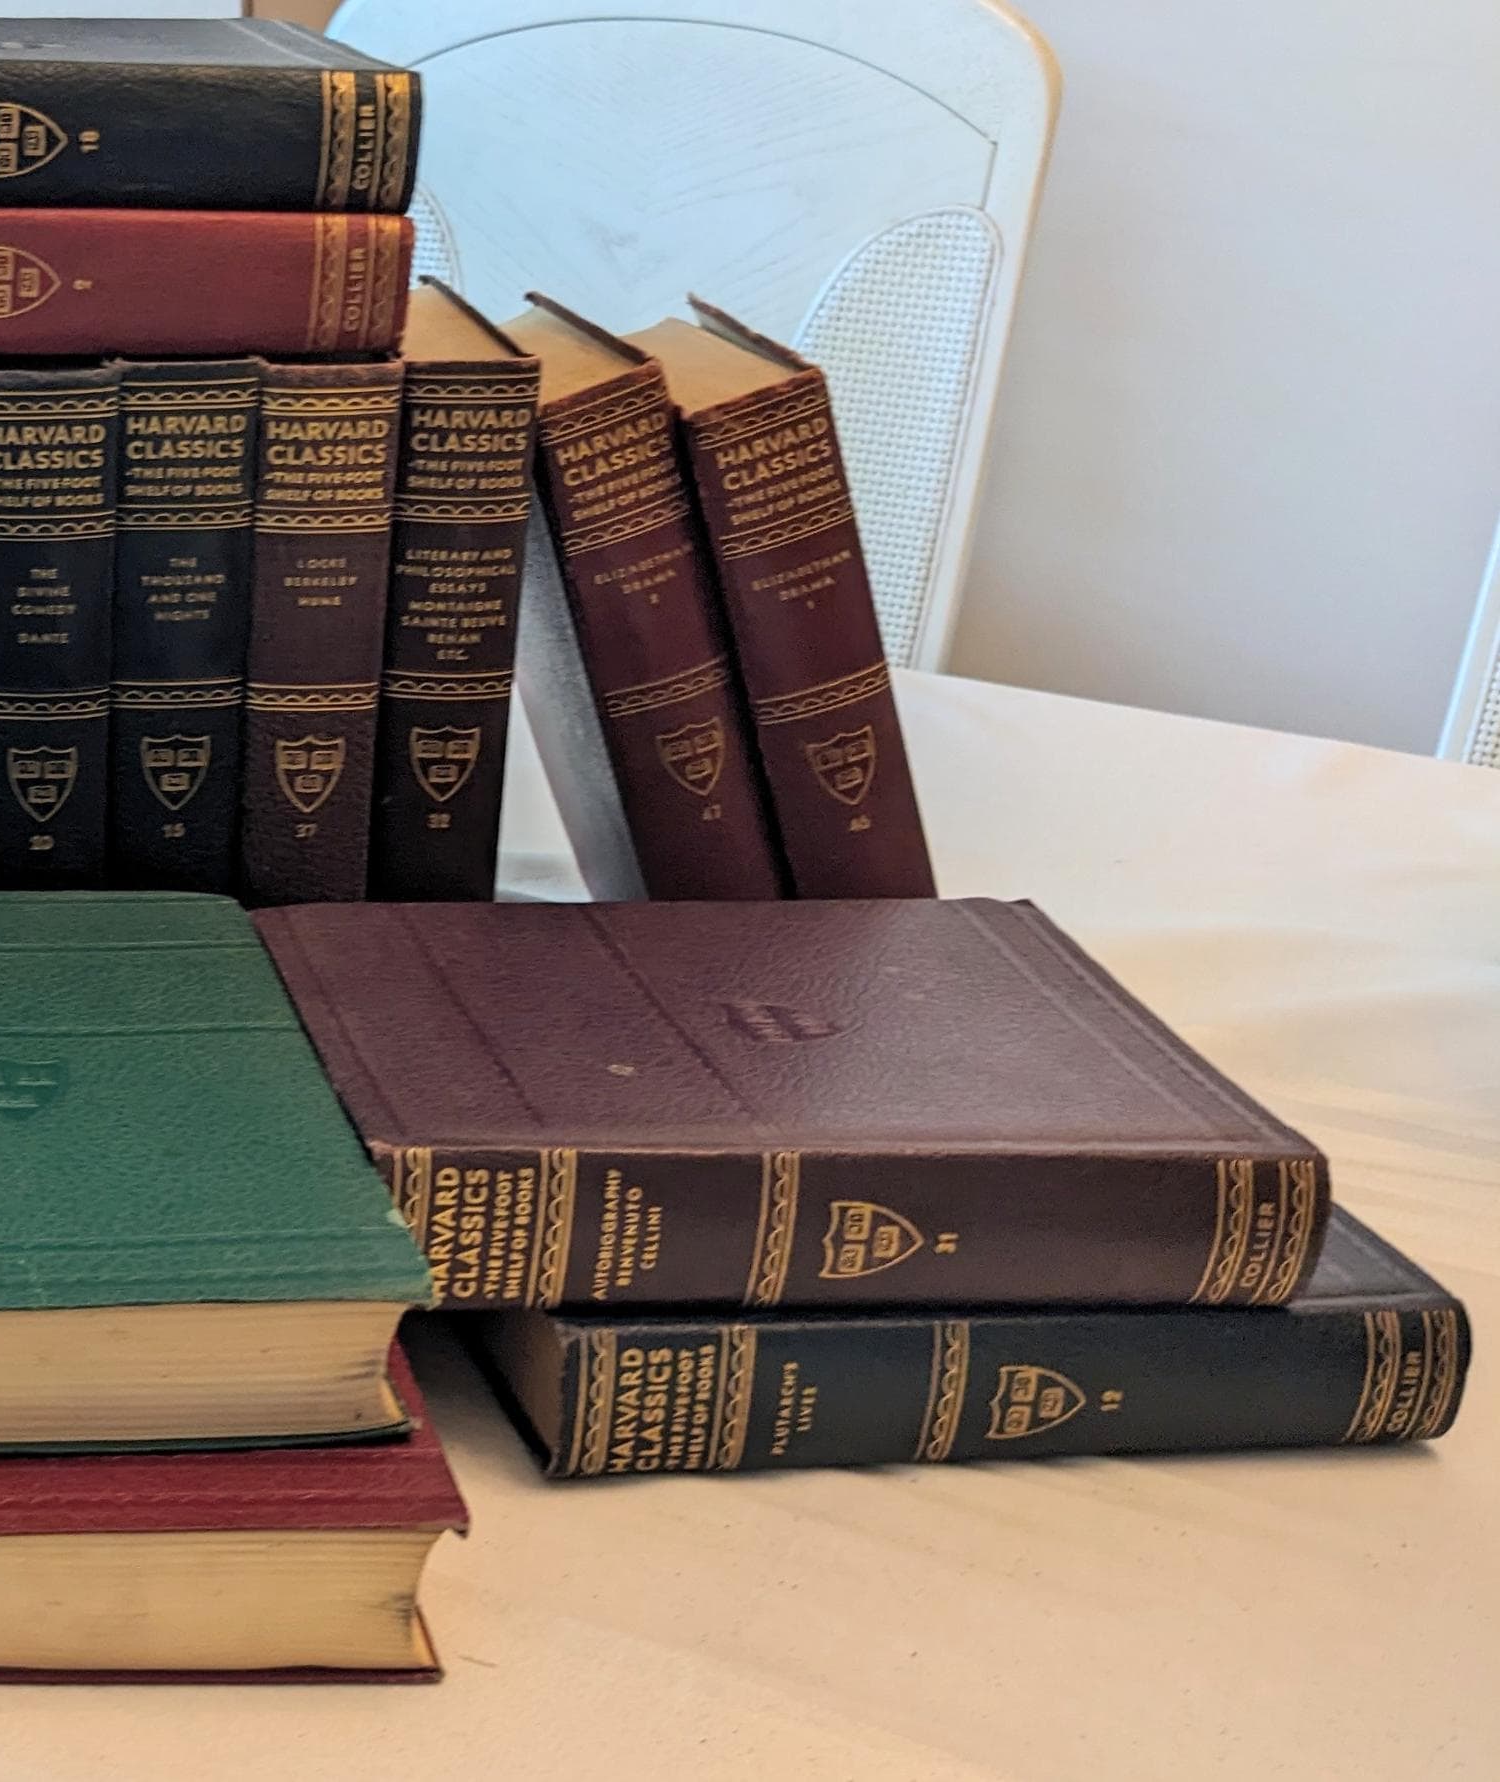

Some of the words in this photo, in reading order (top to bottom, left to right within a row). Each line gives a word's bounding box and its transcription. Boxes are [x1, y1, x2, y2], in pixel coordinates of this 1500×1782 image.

[351, 105, 376, 190] COLLIER
[342, 248, 366, 332] COLLIER
[126, 414, 248, 435] HARVARD
[266, 420, 389, 440] HARVARD
[412, 409, 532, 429] HARVARD
[126, 439, 245, 460] CLASSICS
[410, 432, 528, 452] CLASSICS
[556, 412, 668, 466] HARVARD
[716, 417, 829, 469] HARVARD
[268, 444, 388, 466] CLASSICS
[563, 432, 673, 486] CLASSICS
[722, 440, 833, 490] CLASSICS
[298, 558, 346, 568] LOCKE
[406, 549, 480, 562] LITERARY
[480, 548, 513, 560] AND
[284, 576, 358, 587] BERKELEY
[396, 564, 516, 577] PHILOSOPHICAL
[621, 569, 677, 594] DRAMA
[148, 592, 180, 603] AND
[185, 591, 217, 602] ONE
[428, 582, 486, 594] ESSAYS
[779, 576, 837, 602] DRAMA
[11, 604, 76, 616] COMEDY
[298, 596, 342, 607] HUME
[408, 600, 502, 612] MONTAIGNE
[18, 633, 69, 644] DANTE
[513, 1167, 535, 1224] BOOKS
[451, 1168, 489, 1297] CLASSICS
[510, 1228, 528, 1249] OF
[589, 1169, 622, 1299] AUTOBIOGRAPHY
[614, 1186, 642, 1285] BENVENUTO
[639, 1206, 663, 1268] CELLINI
[1239, 1202, 1277, 1288] COLLIER
[502, 1252, 523, 1298] SHELF
[1387, 1351, 1423, 1433] COLLIER
[607, 1347, 644, 1472] HARVARD
[634, 1348, 673, 1470] CLASSICS
[796, 1386, 817, 1431] LIVES
